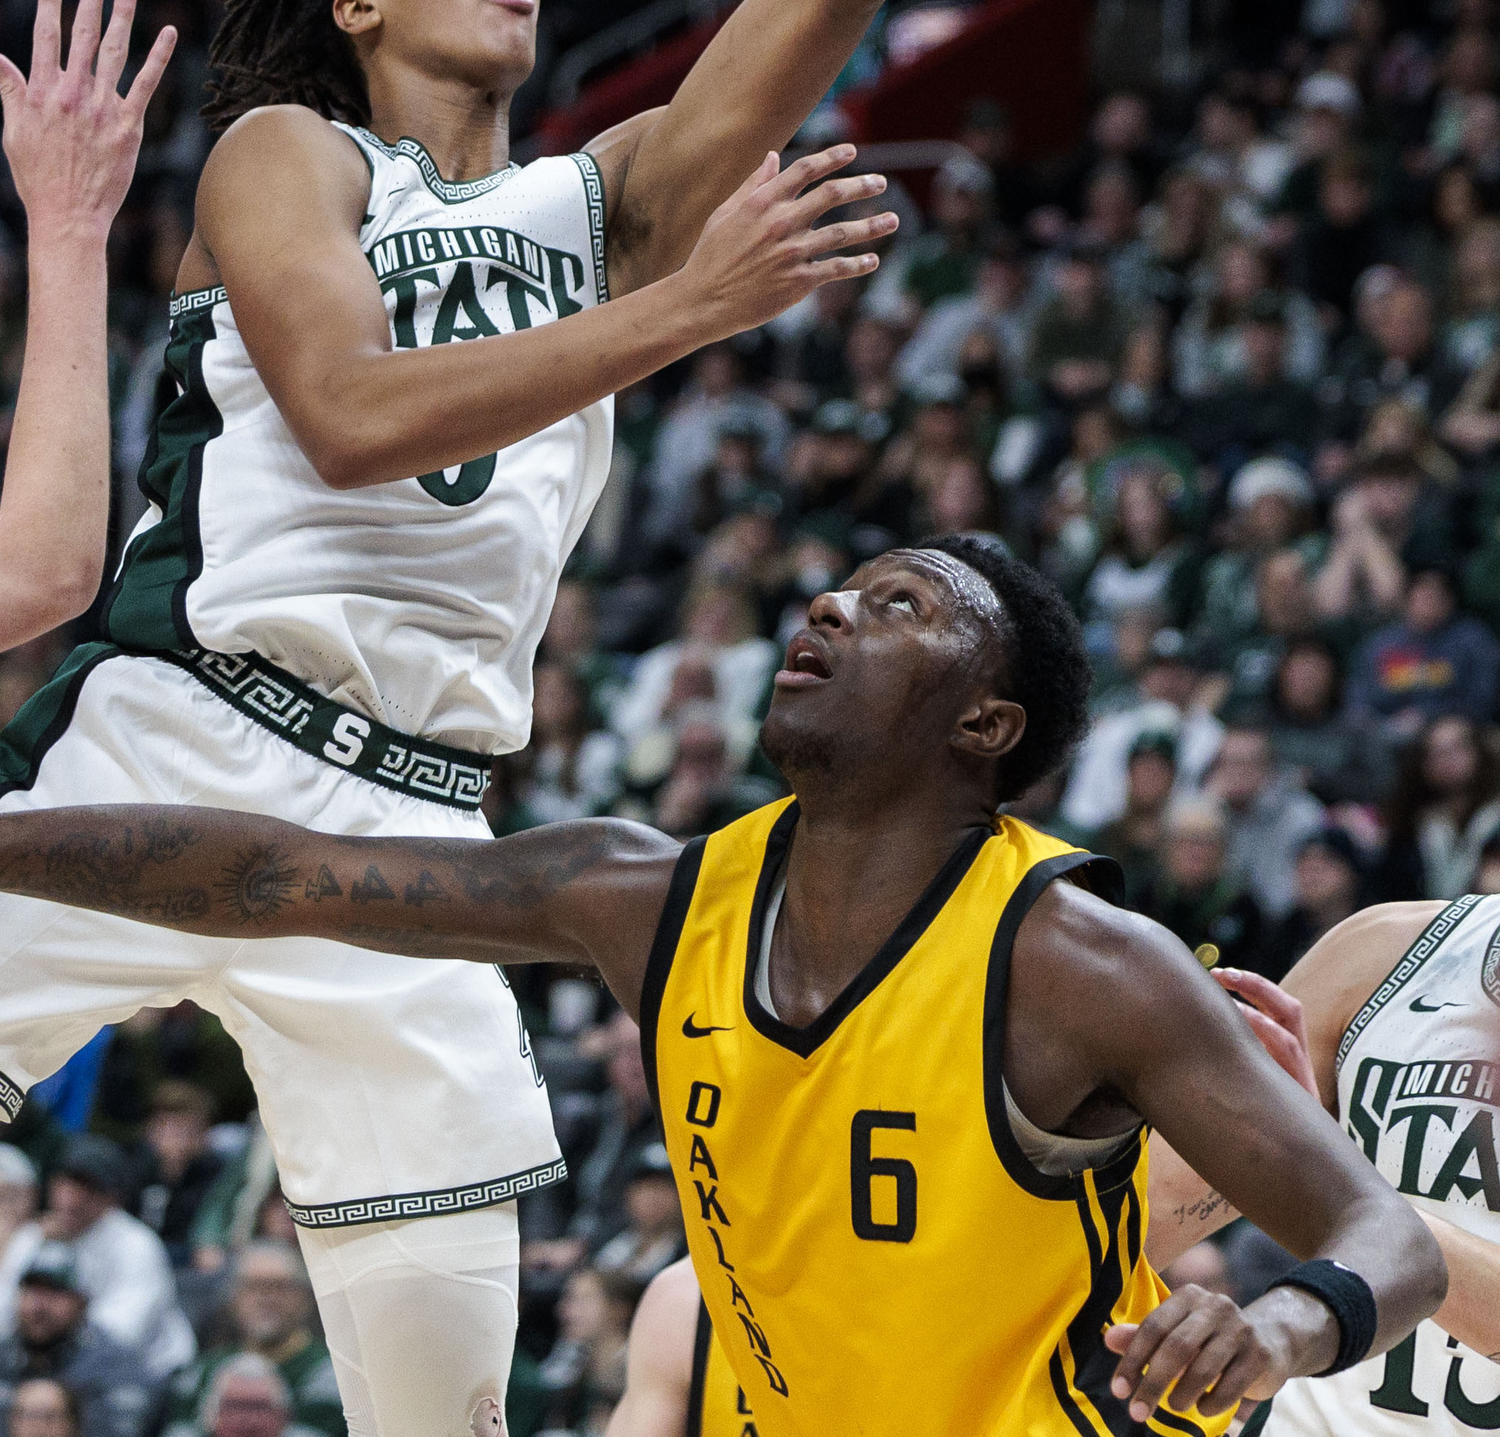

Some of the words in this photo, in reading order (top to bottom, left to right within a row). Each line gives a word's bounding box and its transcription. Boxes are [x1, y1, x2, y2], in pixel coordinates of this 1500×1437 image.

[374, 228, 542, 277] MICHIGAN
[323, 712, 371, 765] S
[850, 1109, 917, 1244] 6
[686, 1081, 789, 1398] OAKLAND
